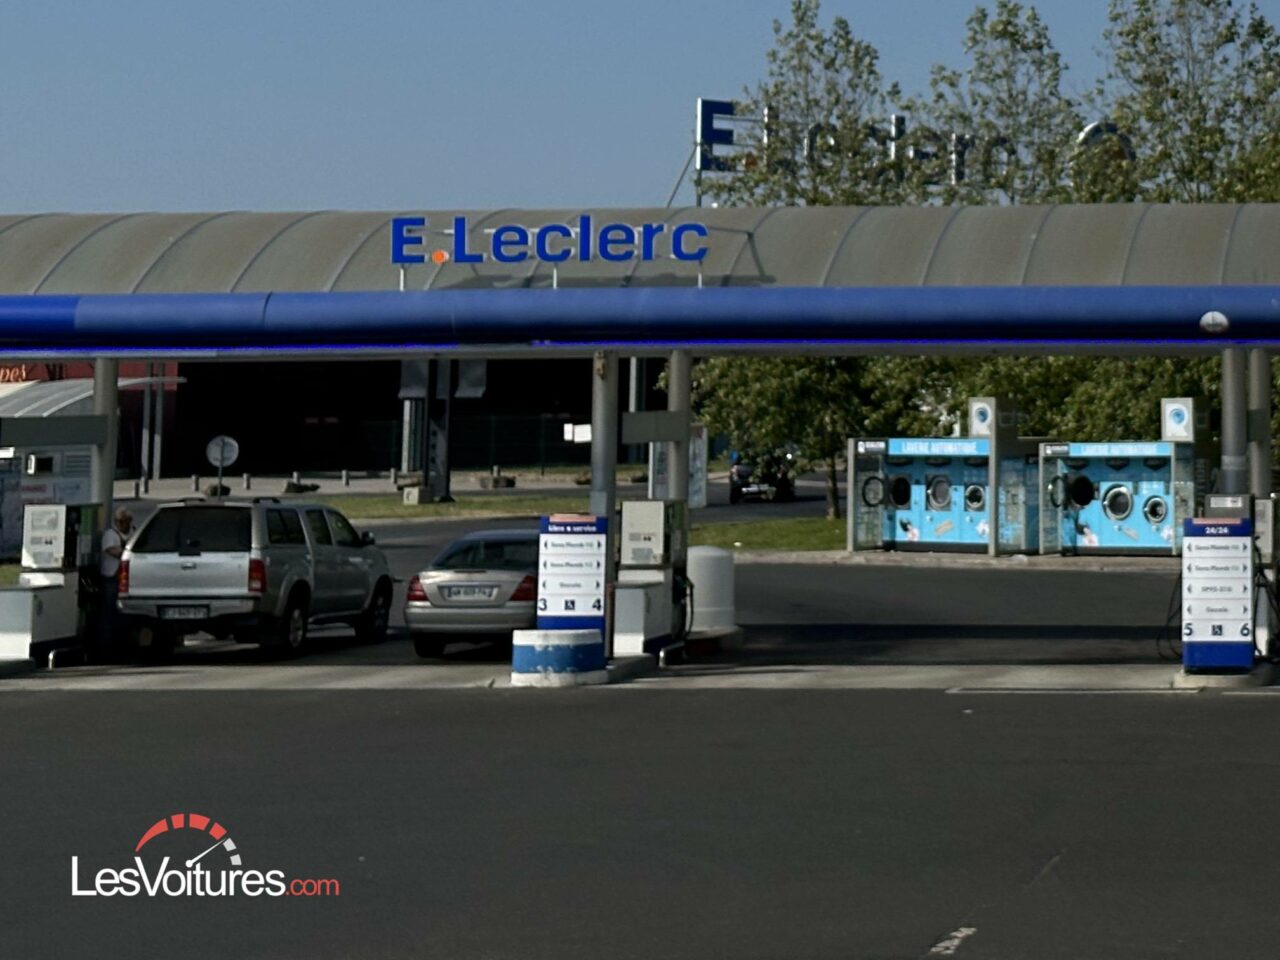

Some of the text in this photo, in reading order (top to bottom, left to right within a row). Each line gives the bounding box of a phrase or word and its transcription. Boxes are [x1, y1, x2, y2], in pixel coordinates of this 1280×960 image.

[391, 215, 709, 264] E.Leclerc
[538, 598, 602, 611] 3 4
[1183, 623, 1250, 637] 5 6
